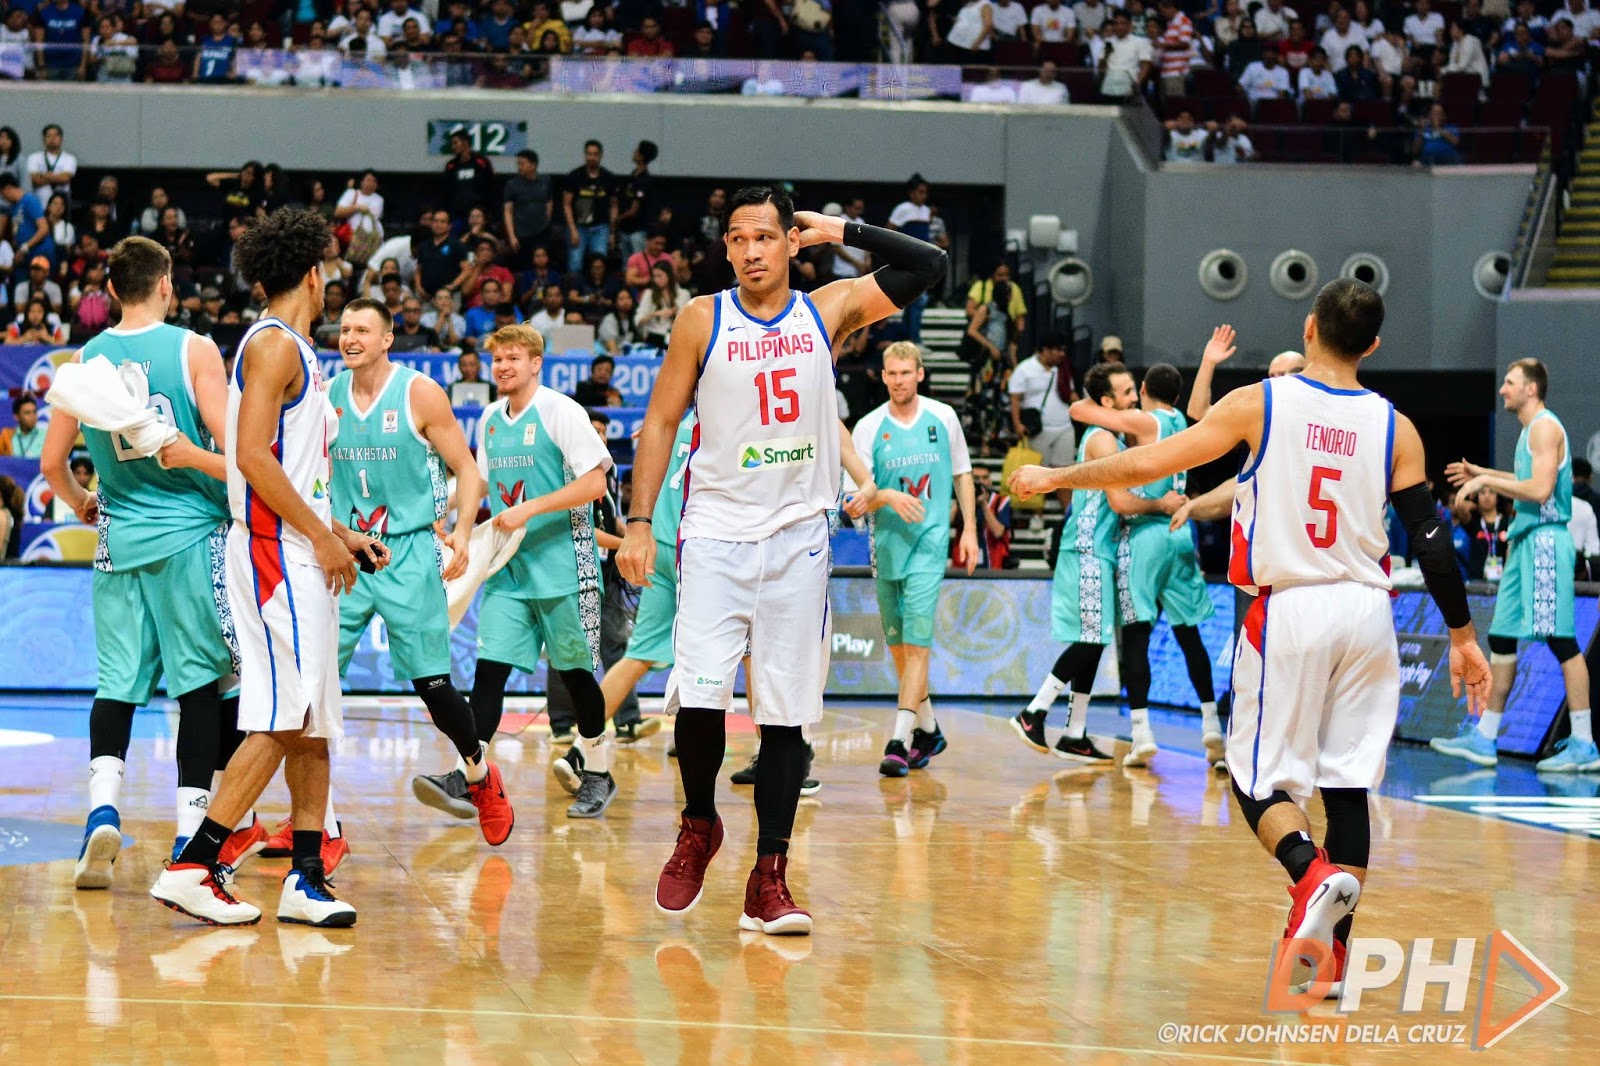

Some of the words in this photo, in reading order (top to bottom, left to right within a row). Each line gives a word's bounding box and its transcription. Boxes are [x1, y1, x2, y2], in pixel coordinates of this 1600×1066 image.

[728, 333, 813, 361] PILIPINAS
[754, 368, 800, 425] 15
[763, 443, 814, 464] Smart
[1306, 423, 1357, 457] TENORIO
[886, 452, 940, 470] KAZAKHSTAN
[358, 468, 371, 498] 1
[1305, 465, 1342, 549] 5
[832, 632, 874, 657] Play
